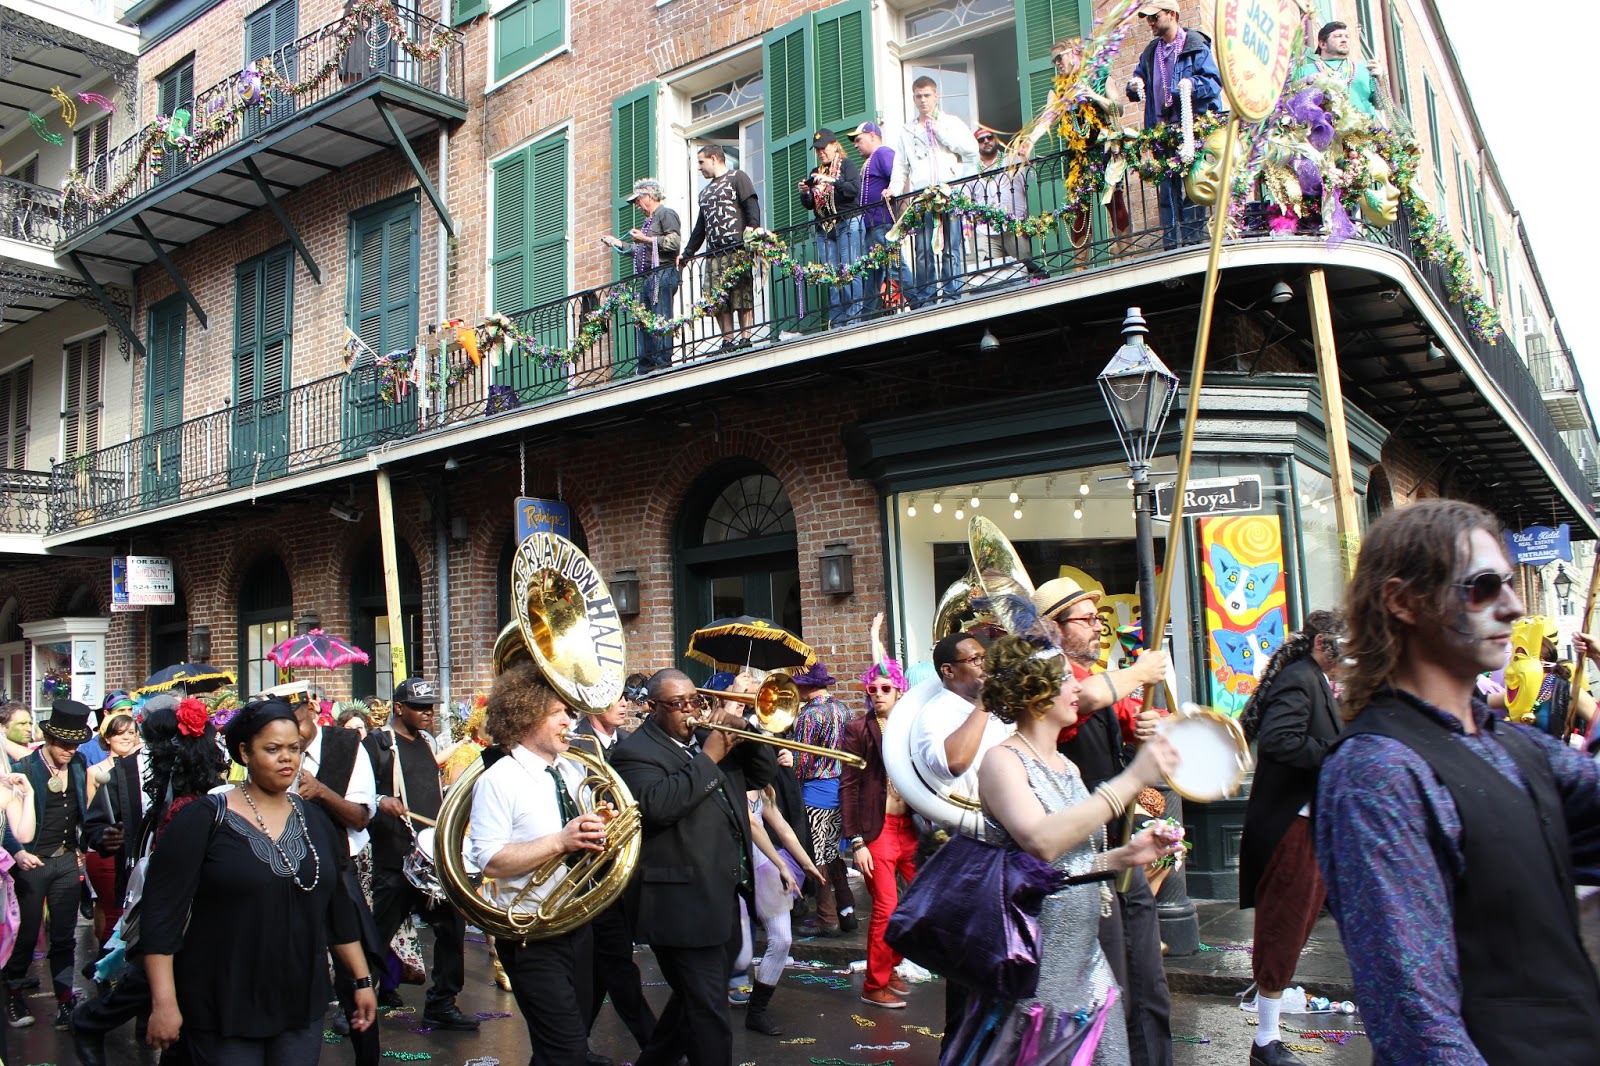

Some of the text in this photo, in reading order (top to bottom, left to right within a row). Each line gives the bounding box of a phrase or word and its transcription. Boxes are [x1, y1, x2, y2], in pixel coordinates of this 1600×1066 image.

[1247, 0, 1275, 42] JAZZ
[1242, 22, 1271, 66] BAND
[1270, 24, 1290, 89] HALL
[1183, 488, 1236, 511] Royal
[1512, 533, 1534, 542] Ethel
[1518, 550, 1560, 558] ENTRANCE
[586, 595, 624, 668] HALL
